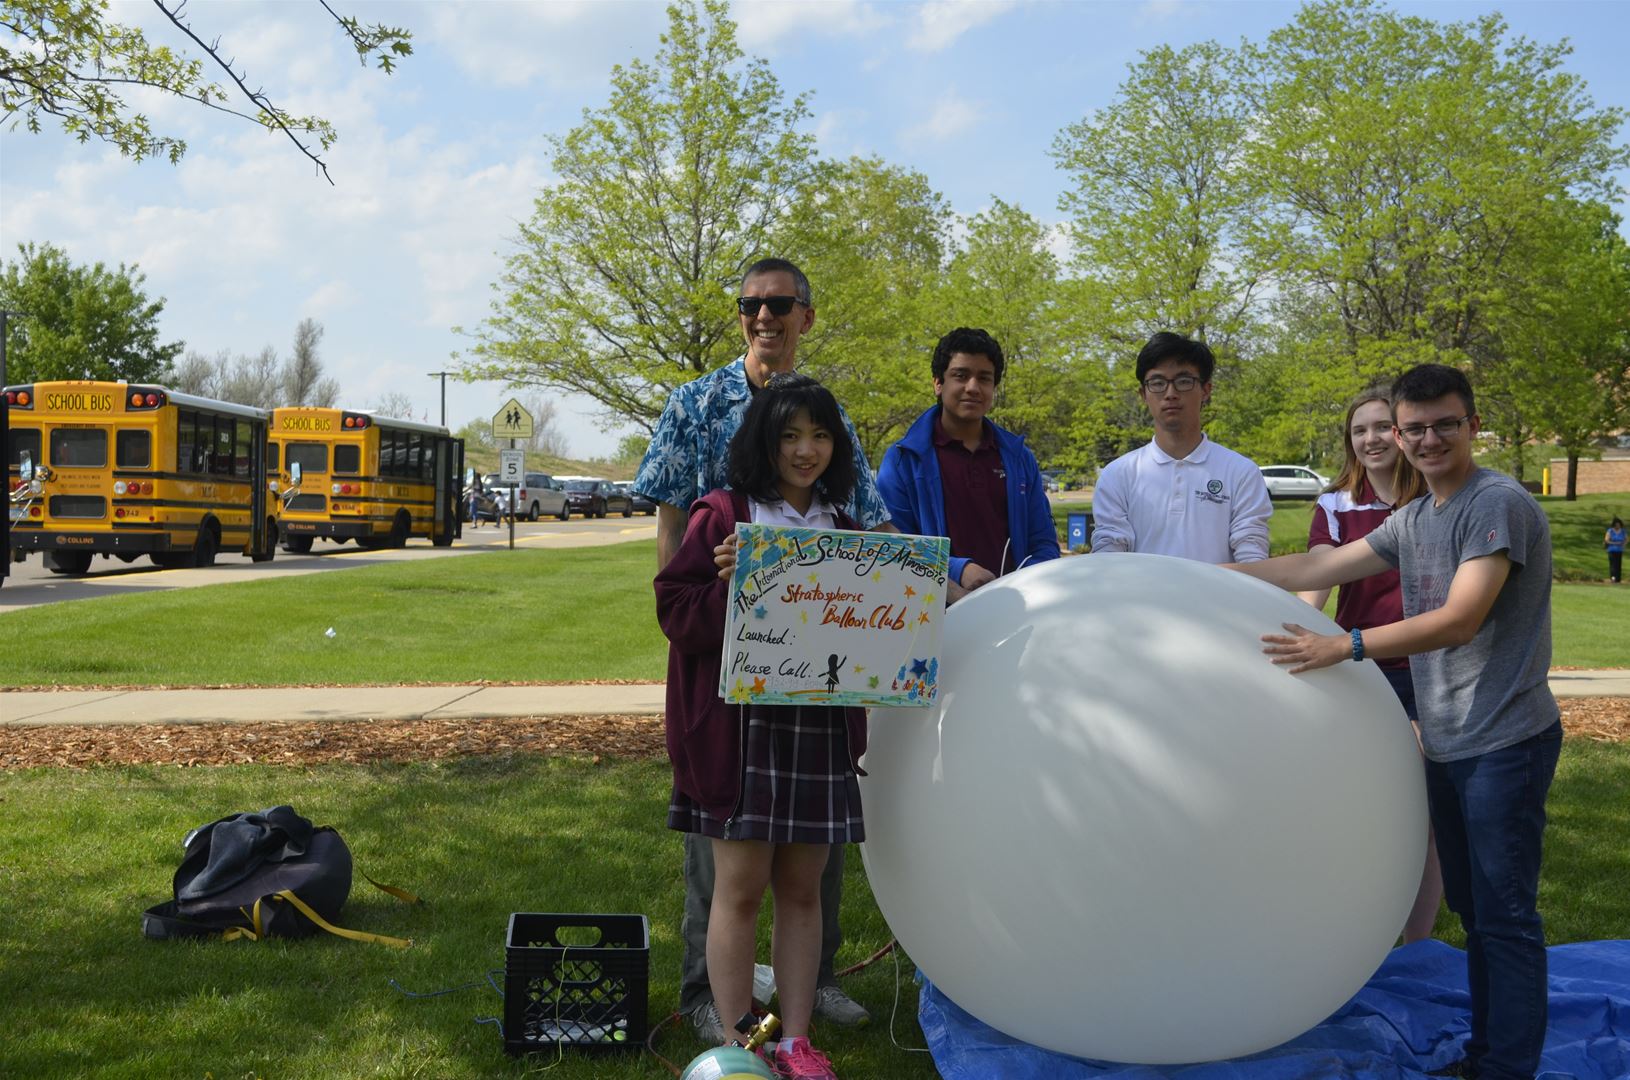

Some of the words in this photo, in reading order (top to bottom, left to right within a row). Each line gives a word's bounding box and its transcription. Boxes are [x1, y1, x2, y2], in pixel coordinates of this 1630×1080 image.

[48, 394, 87, 410] SCHOOL
[91, 394, 112, 411] BUS
[283, 416, 313, 431] SCHOOL
[315, 418, 331, 431] BUS
[508, 463, 517, 475] 5
[734, 590, 760, 615] The
[749, 536, 808, 598] International
[798, 535, 863, 567] School
[855, 543, 890, 577] of
[781, 582, 865, 613] Stratospheric
[819, 604, 868, 629] Balloon
[868, 603, 907, 630] Club
[731, 651, 772, 675] Please
